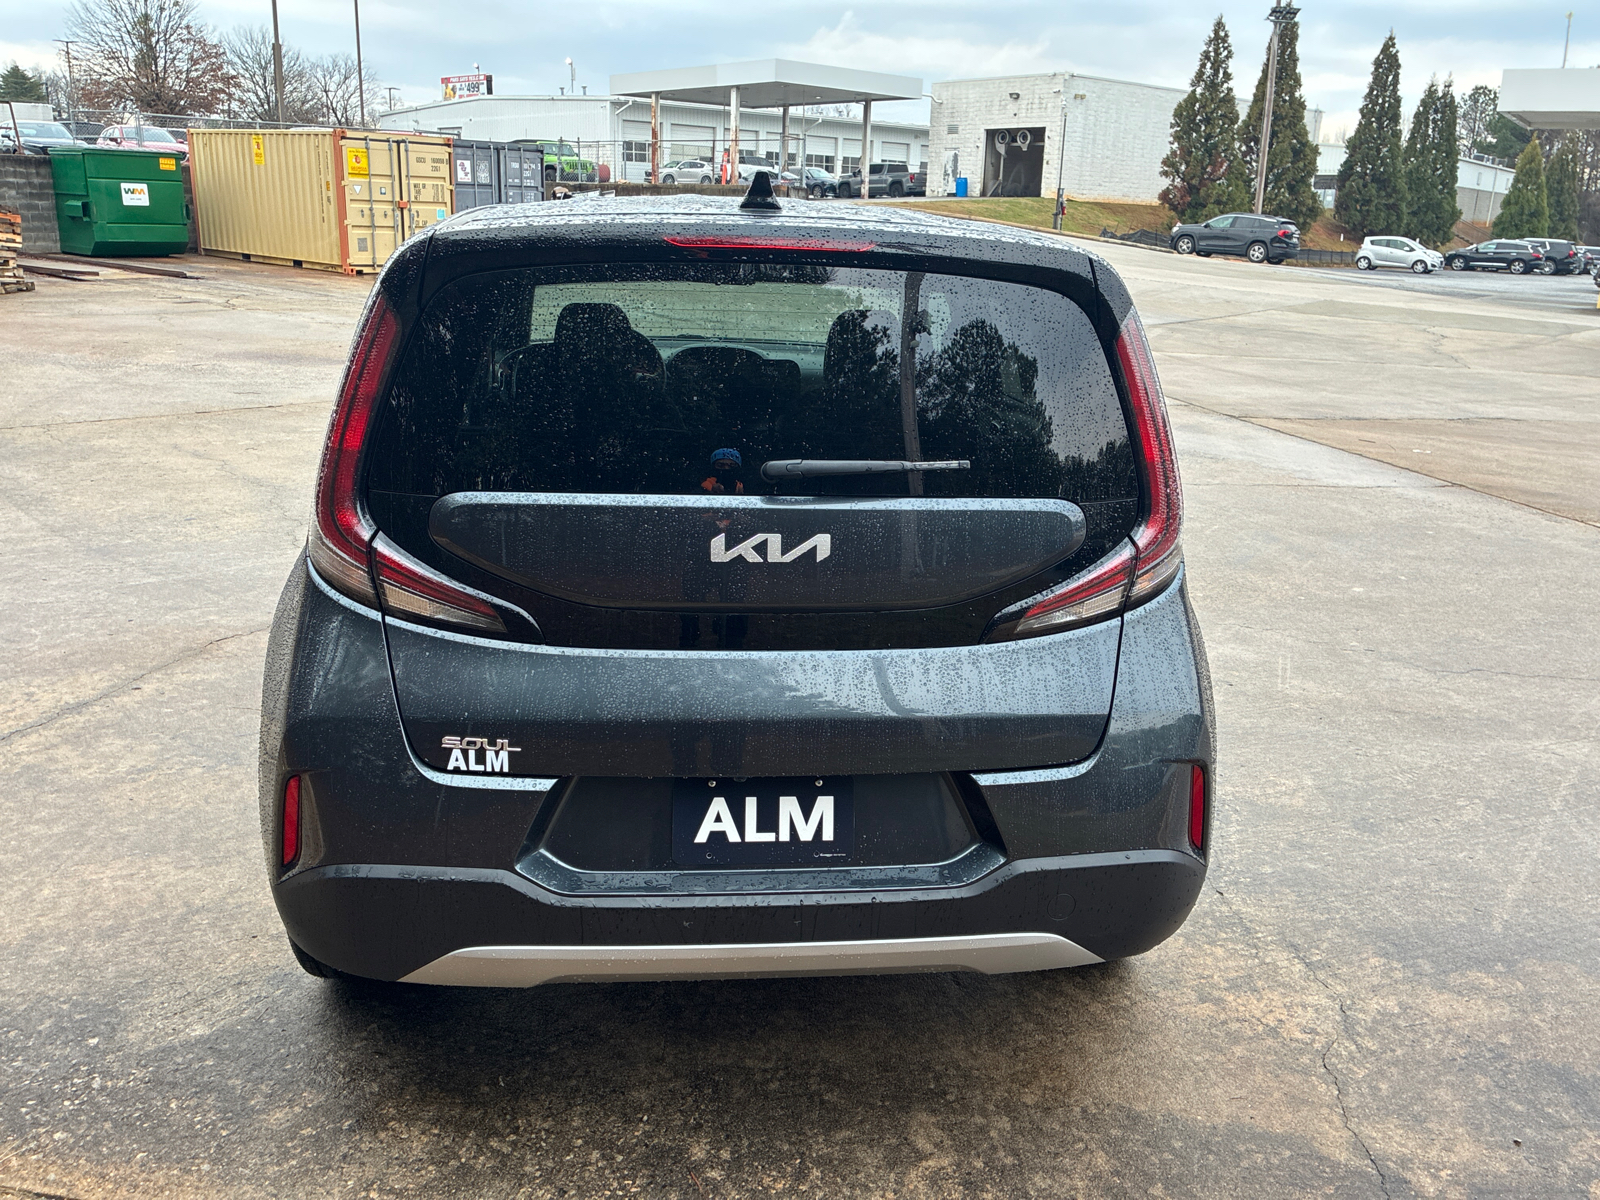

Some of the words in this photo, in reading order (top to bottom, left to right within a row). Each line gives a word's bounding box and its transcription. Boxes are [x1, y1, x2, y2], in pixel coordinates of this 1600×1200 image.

[710, 533, 831, 562] KIA
[441, 736, 521, 751] SOUL
[447, 749, 509, 772] ALM
[693, 796, 834, 843] ALM
